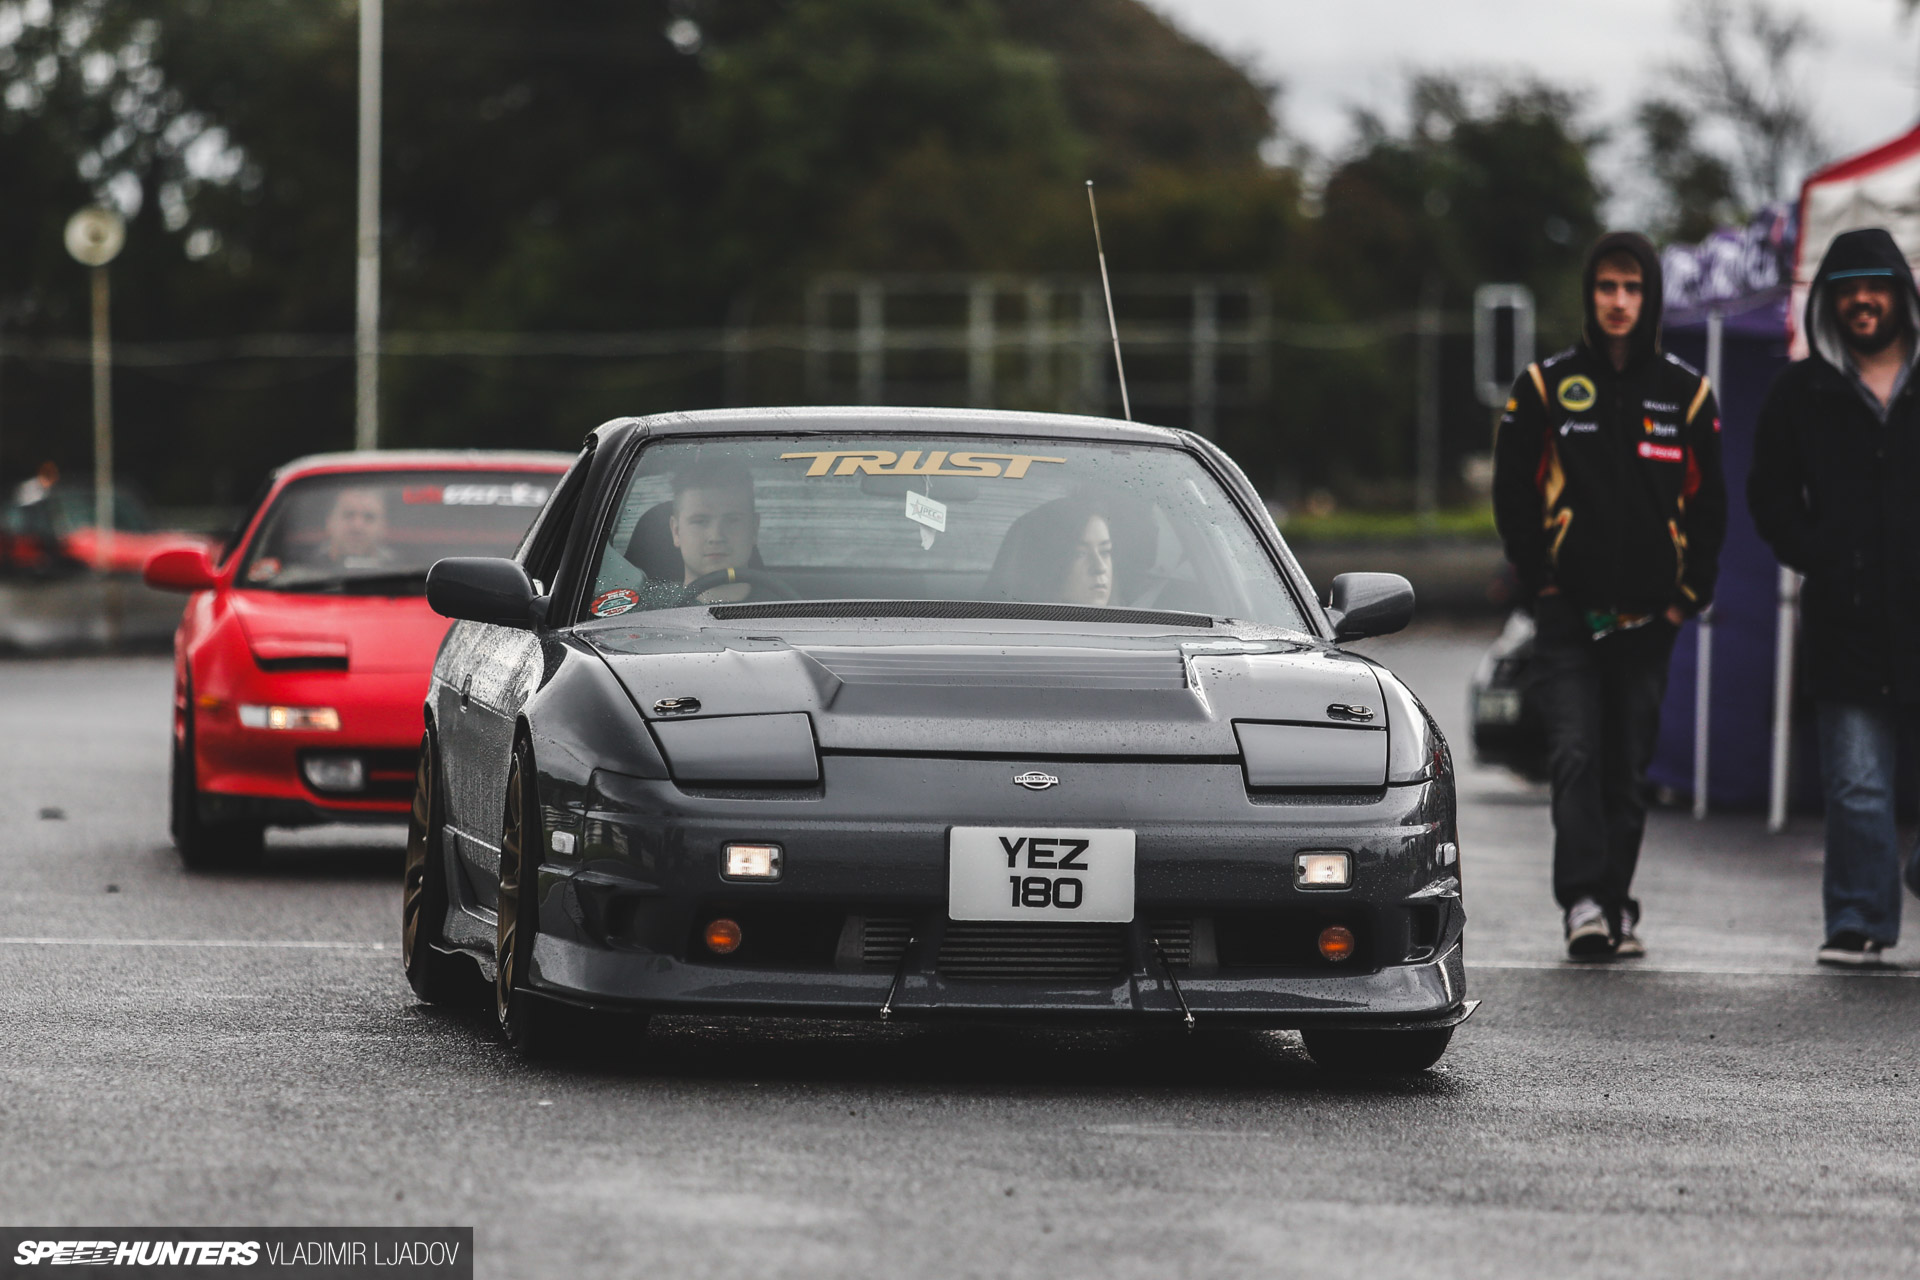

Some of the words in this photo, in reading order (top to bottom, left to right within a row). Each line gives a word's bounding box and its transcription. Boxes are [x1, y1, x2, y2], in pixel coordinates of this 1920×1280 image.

[780, 450, 1068, 479] TRUST
[1015, 775, 1057, 783] NISSAN
[998, 836, 1089, 870] YEZ
[1010, 875, 1083, 909] 180
